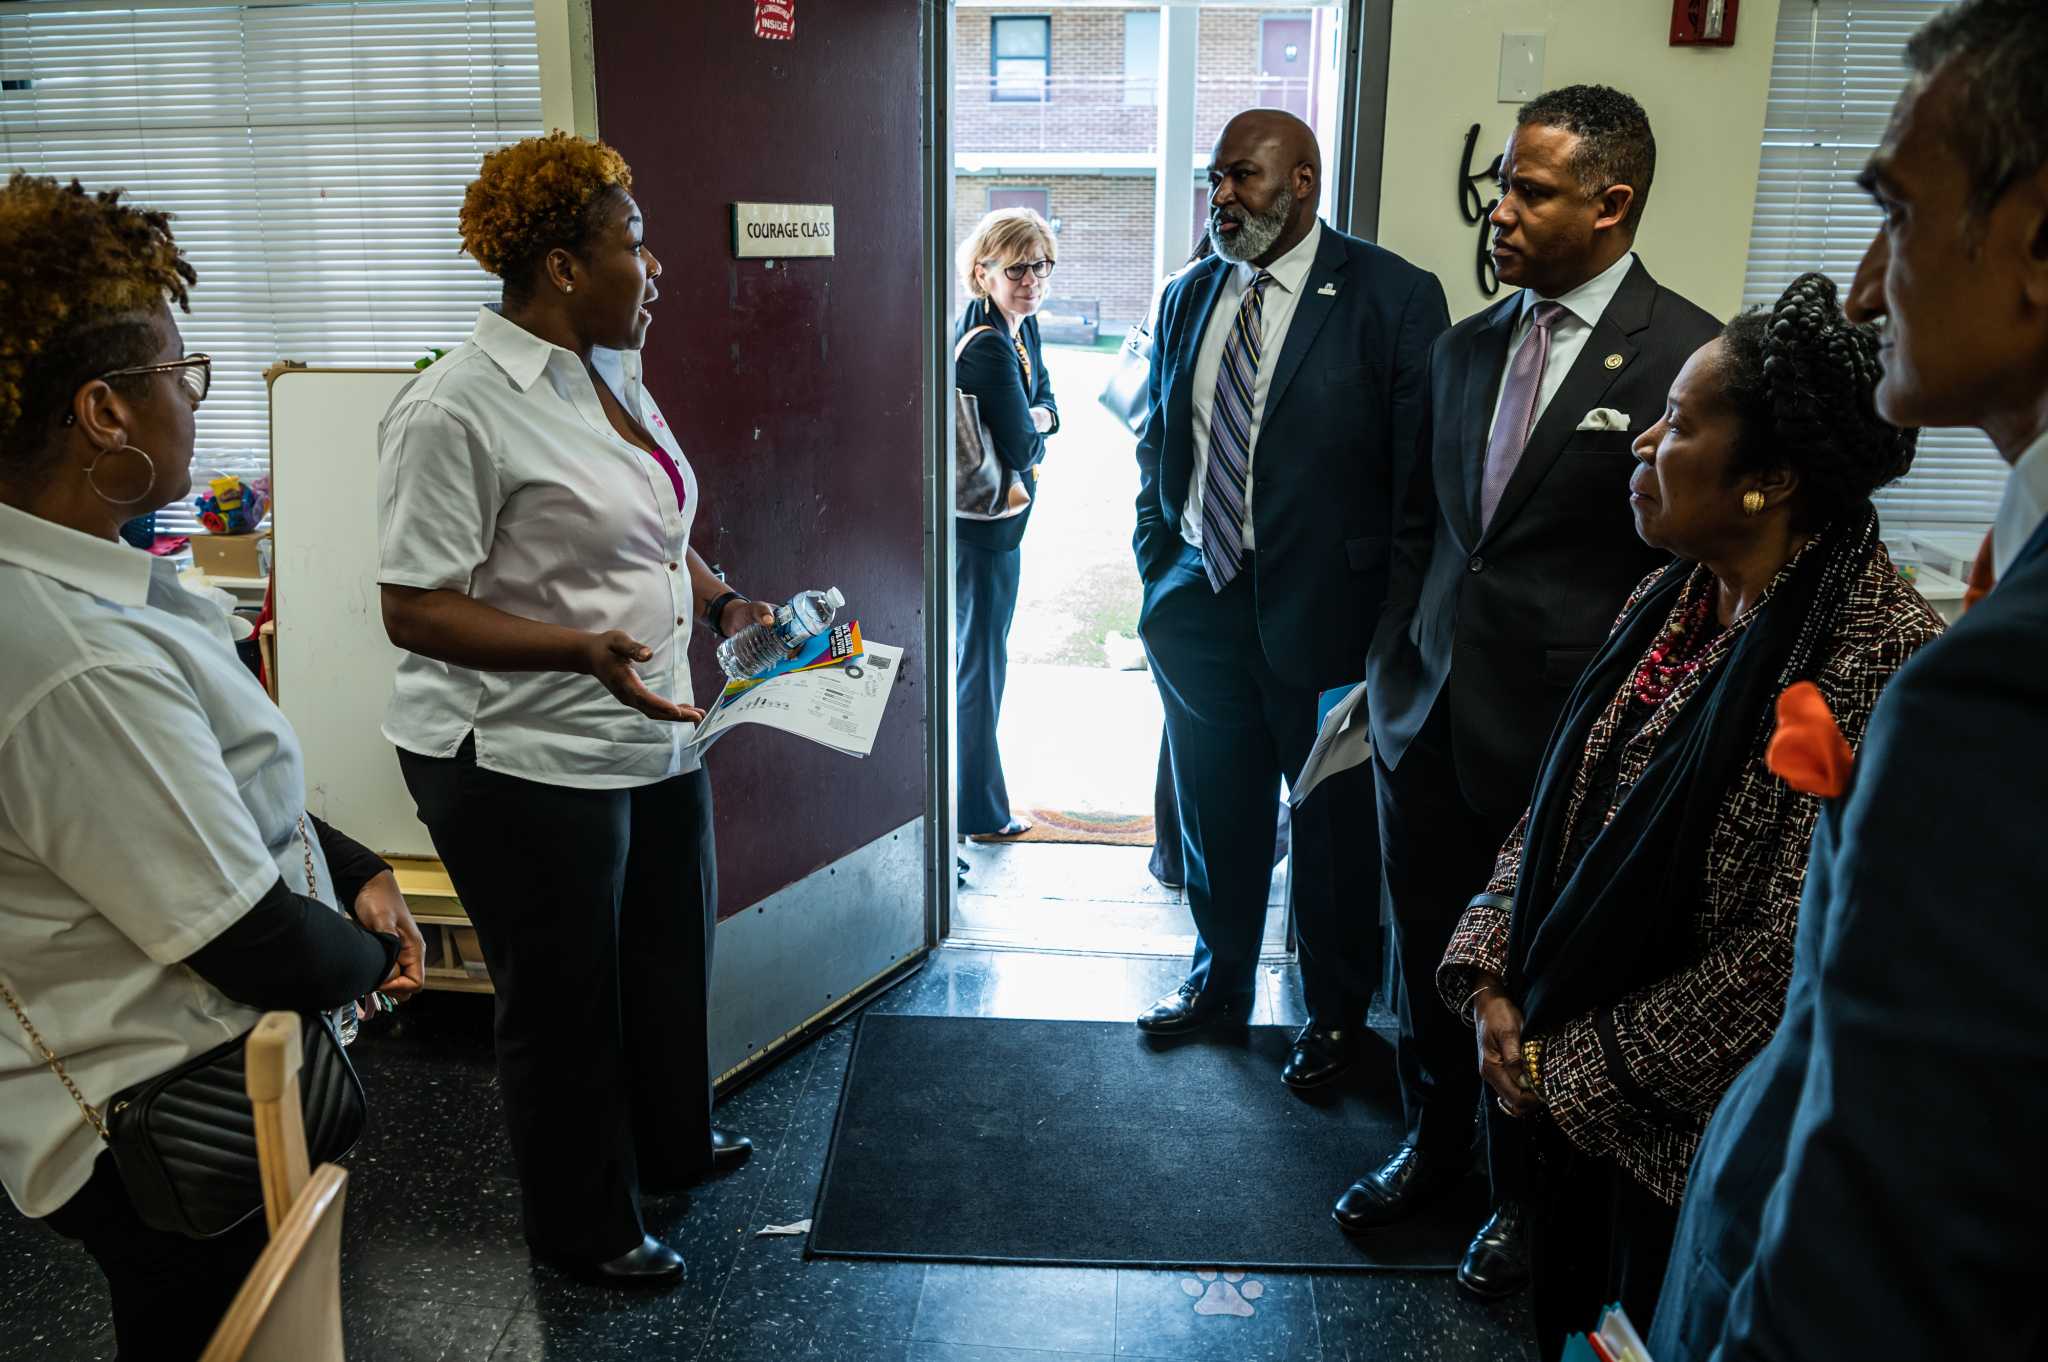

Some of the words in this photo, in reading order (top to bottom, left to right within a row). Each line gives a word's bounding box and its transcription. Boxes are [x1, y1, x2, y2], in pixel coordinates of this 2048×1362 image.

[761, 17, 788, 31] INSIDE
[747, 222, 799, 238] COURAGE
[801, 222, 830, 237] CLASS
